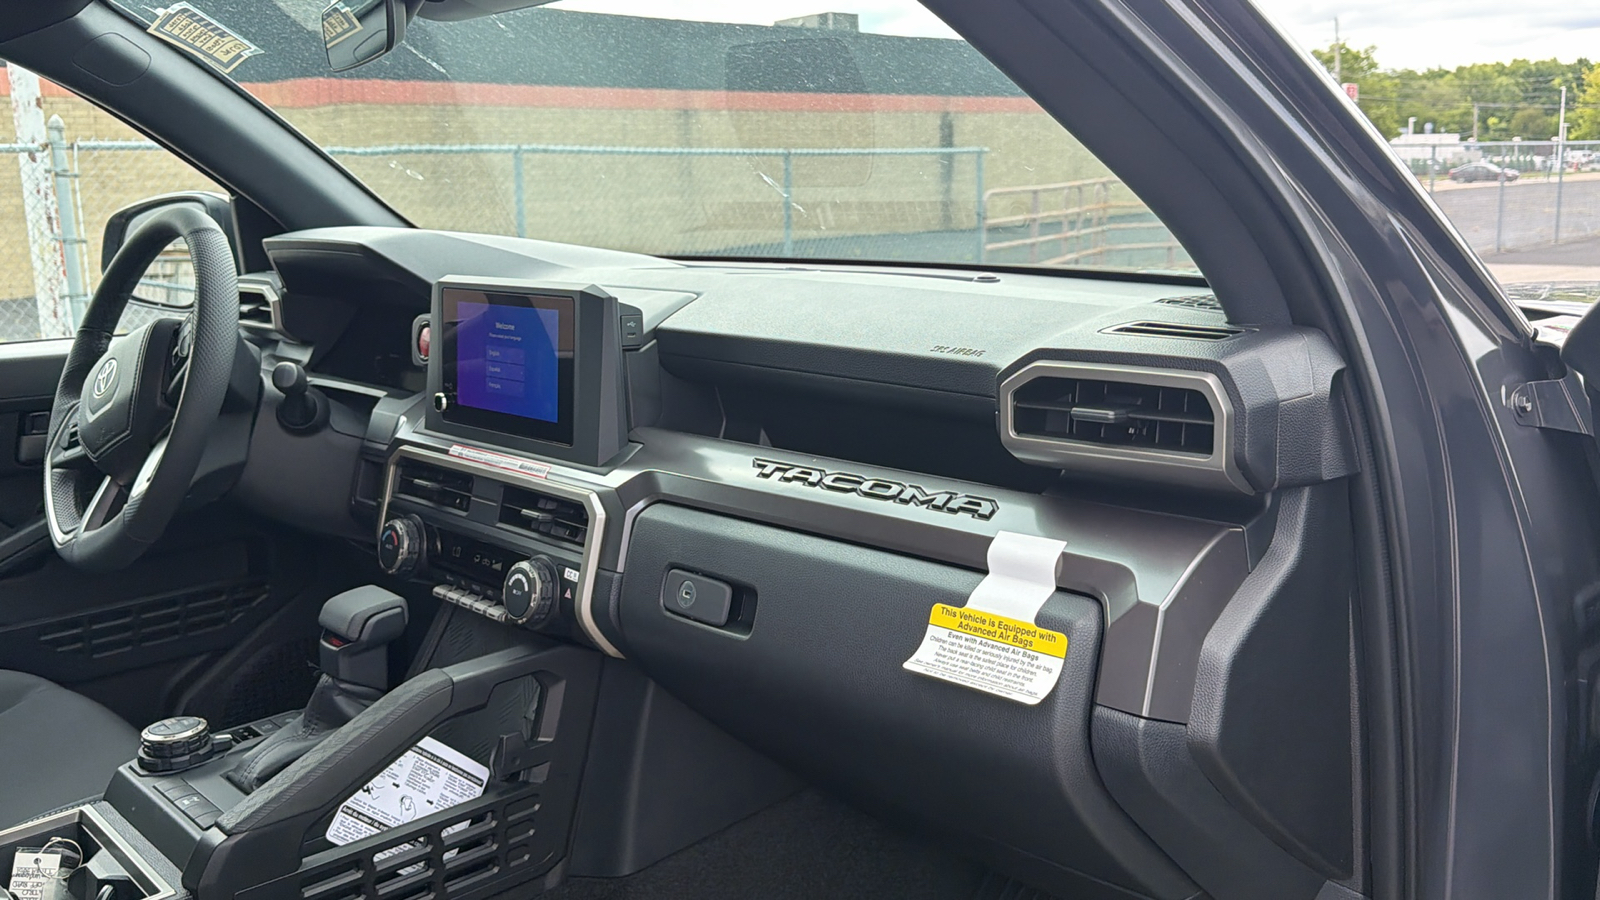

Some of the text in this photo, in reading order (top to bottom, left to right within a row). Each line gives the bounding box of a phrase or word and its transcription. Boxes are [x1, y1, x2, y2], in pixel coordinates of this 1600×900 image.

[752, 458, 1000, 521] TACOMA
[941, 606, 1056, 642] This Vehicle is Equipped with
[958, 621, 1033, 648] Advanced Air Bags
[930, 635, 948, 644] Children
[948, 632, 962, 641] Even
[965, 636, 977, 644] with
[978, 640, 1010, 653] Advanced
[1022, 651, 1039, 661] Bags
